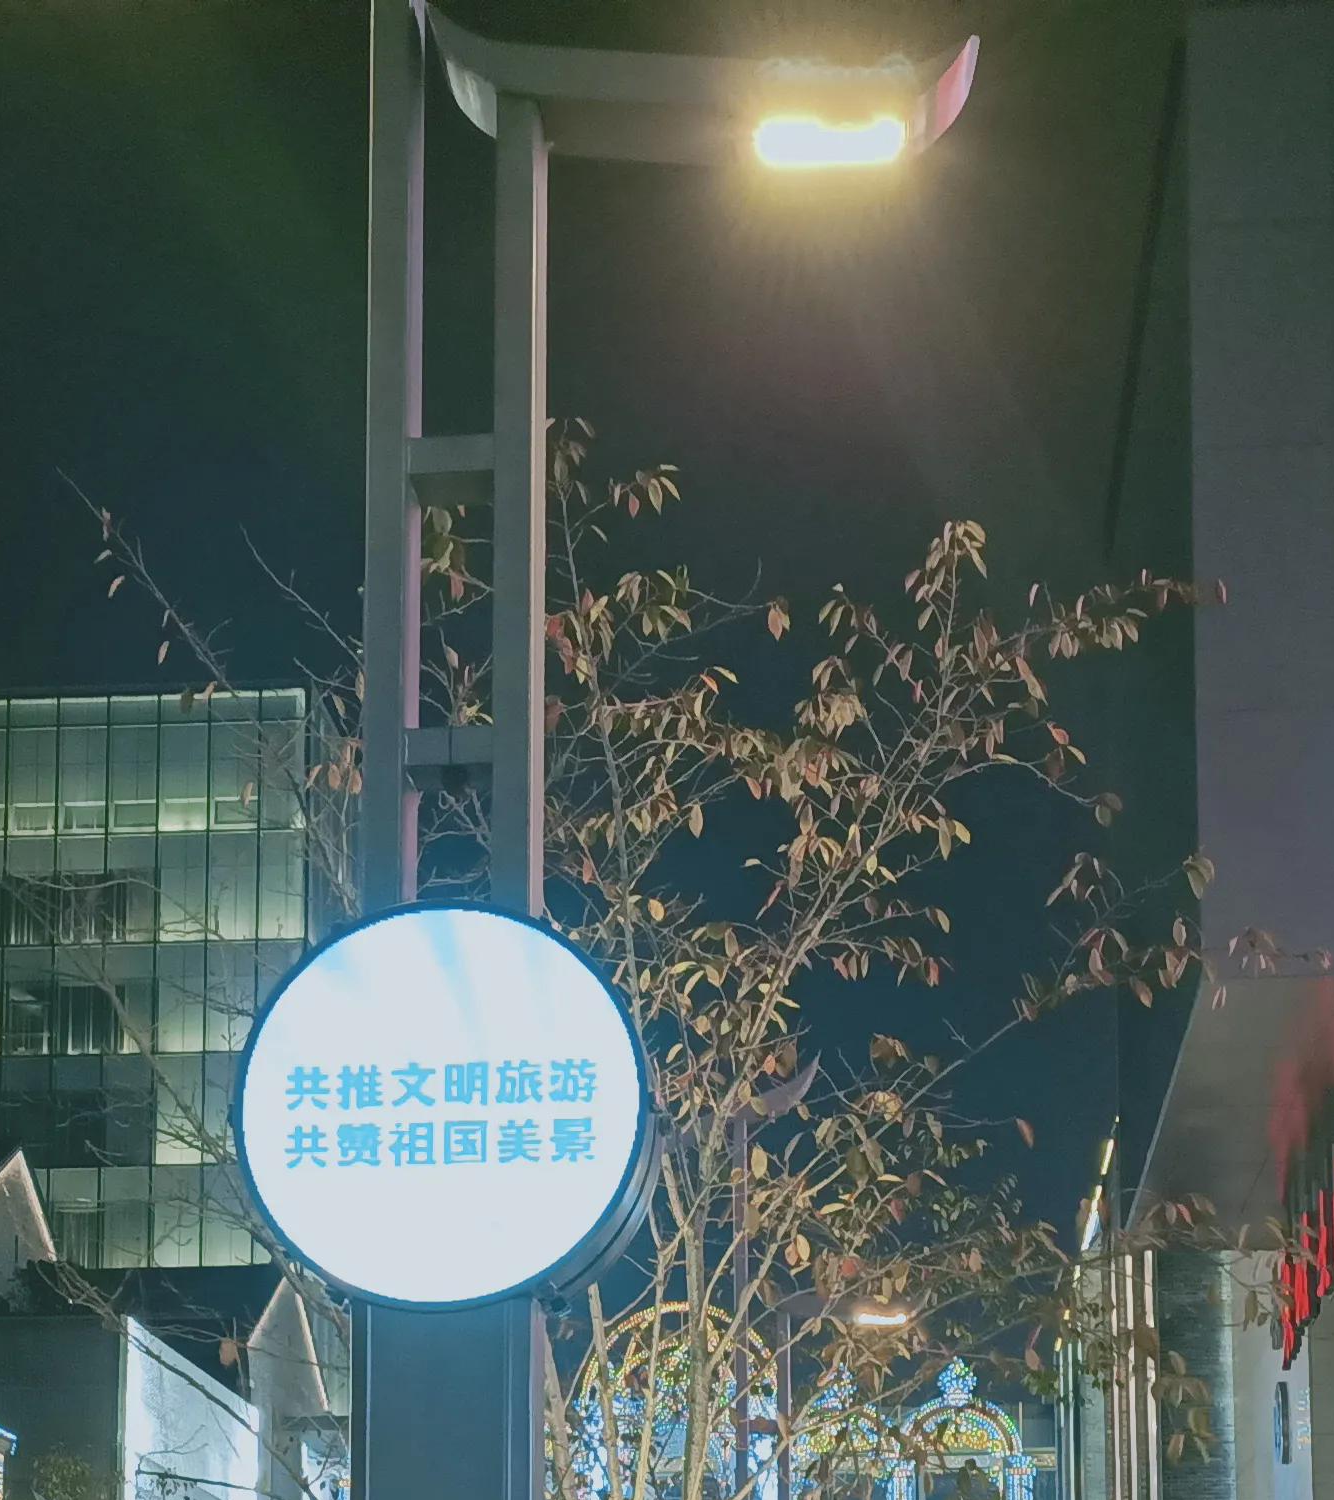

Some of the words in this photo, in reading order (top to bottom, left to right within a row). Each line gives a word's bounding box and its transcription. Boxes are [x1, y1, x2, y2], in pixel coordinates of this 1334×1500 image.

[284, 1058, 598, 1111] 共推文明旅游
[284, 1116, 597, 1169] 共赞祖国美景
